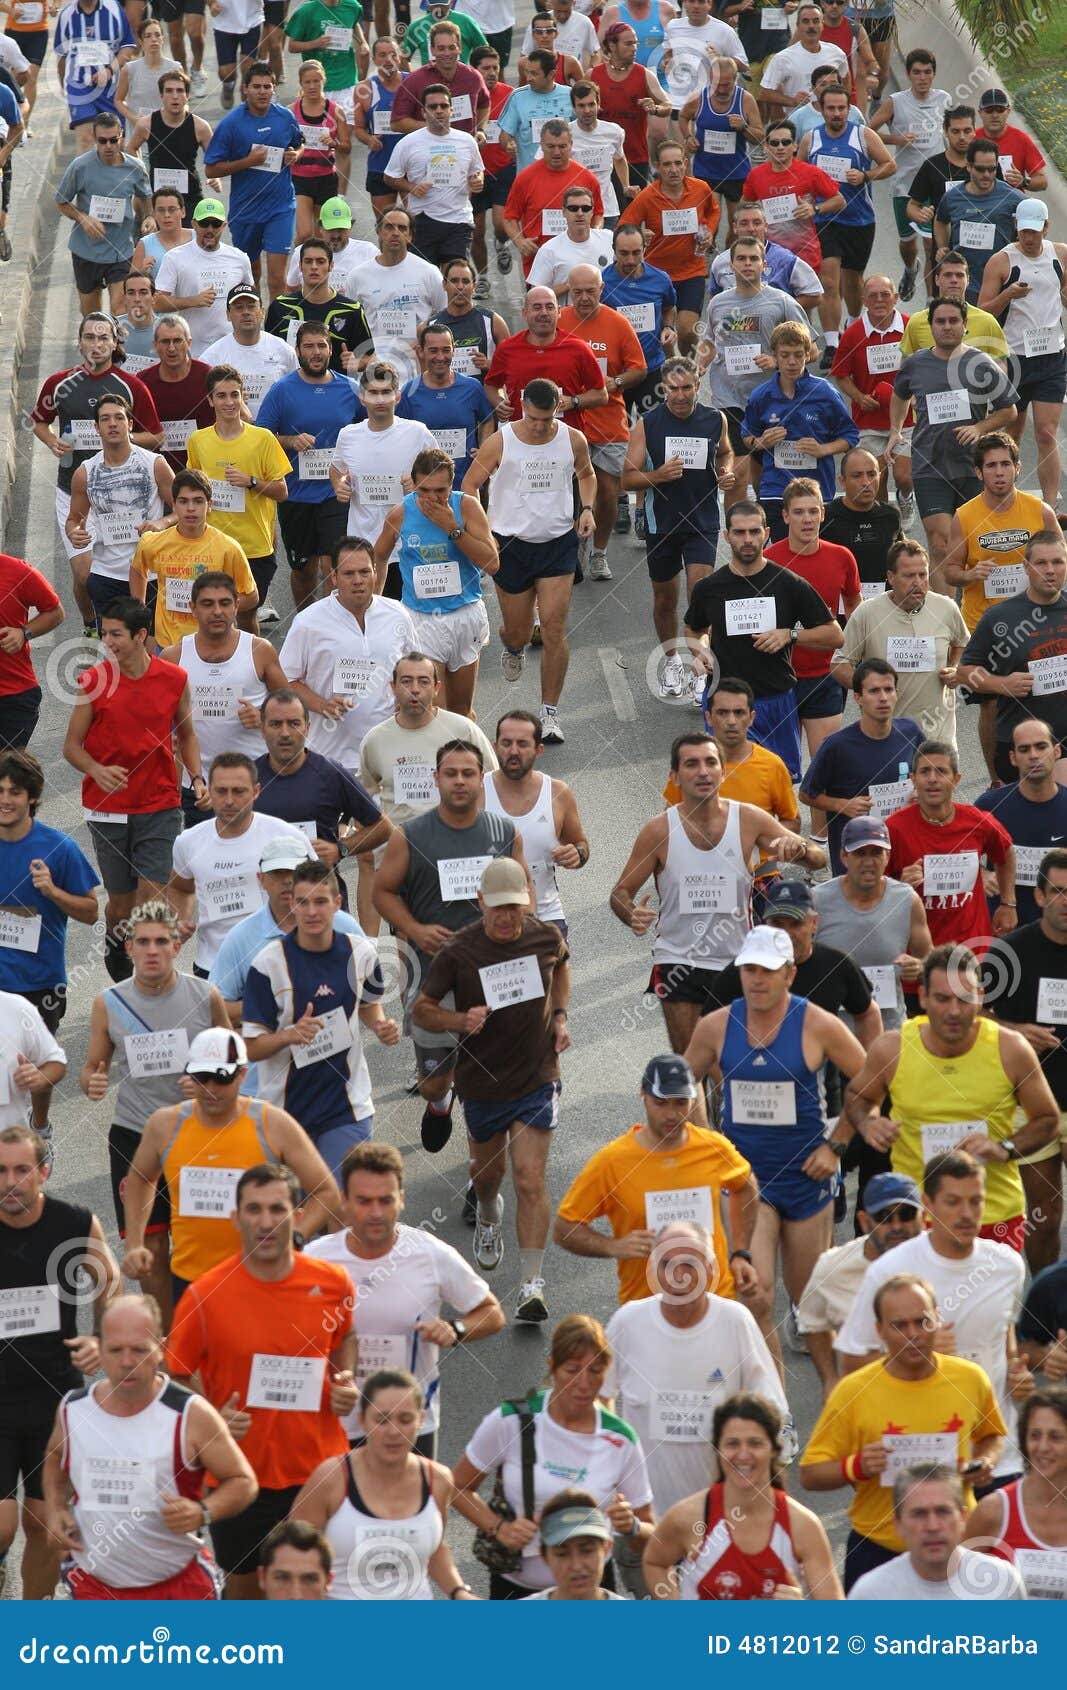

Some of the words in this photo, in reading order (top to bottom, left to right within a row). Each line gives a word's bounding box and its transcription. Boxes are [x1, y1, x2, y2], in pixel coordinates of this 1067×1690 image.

[733, 612, 762, 621] 001421
[341, 672, 370, 681] 009152
[214, 862, 233, 870] RUN
[688, 889, 721, 898] 012011
